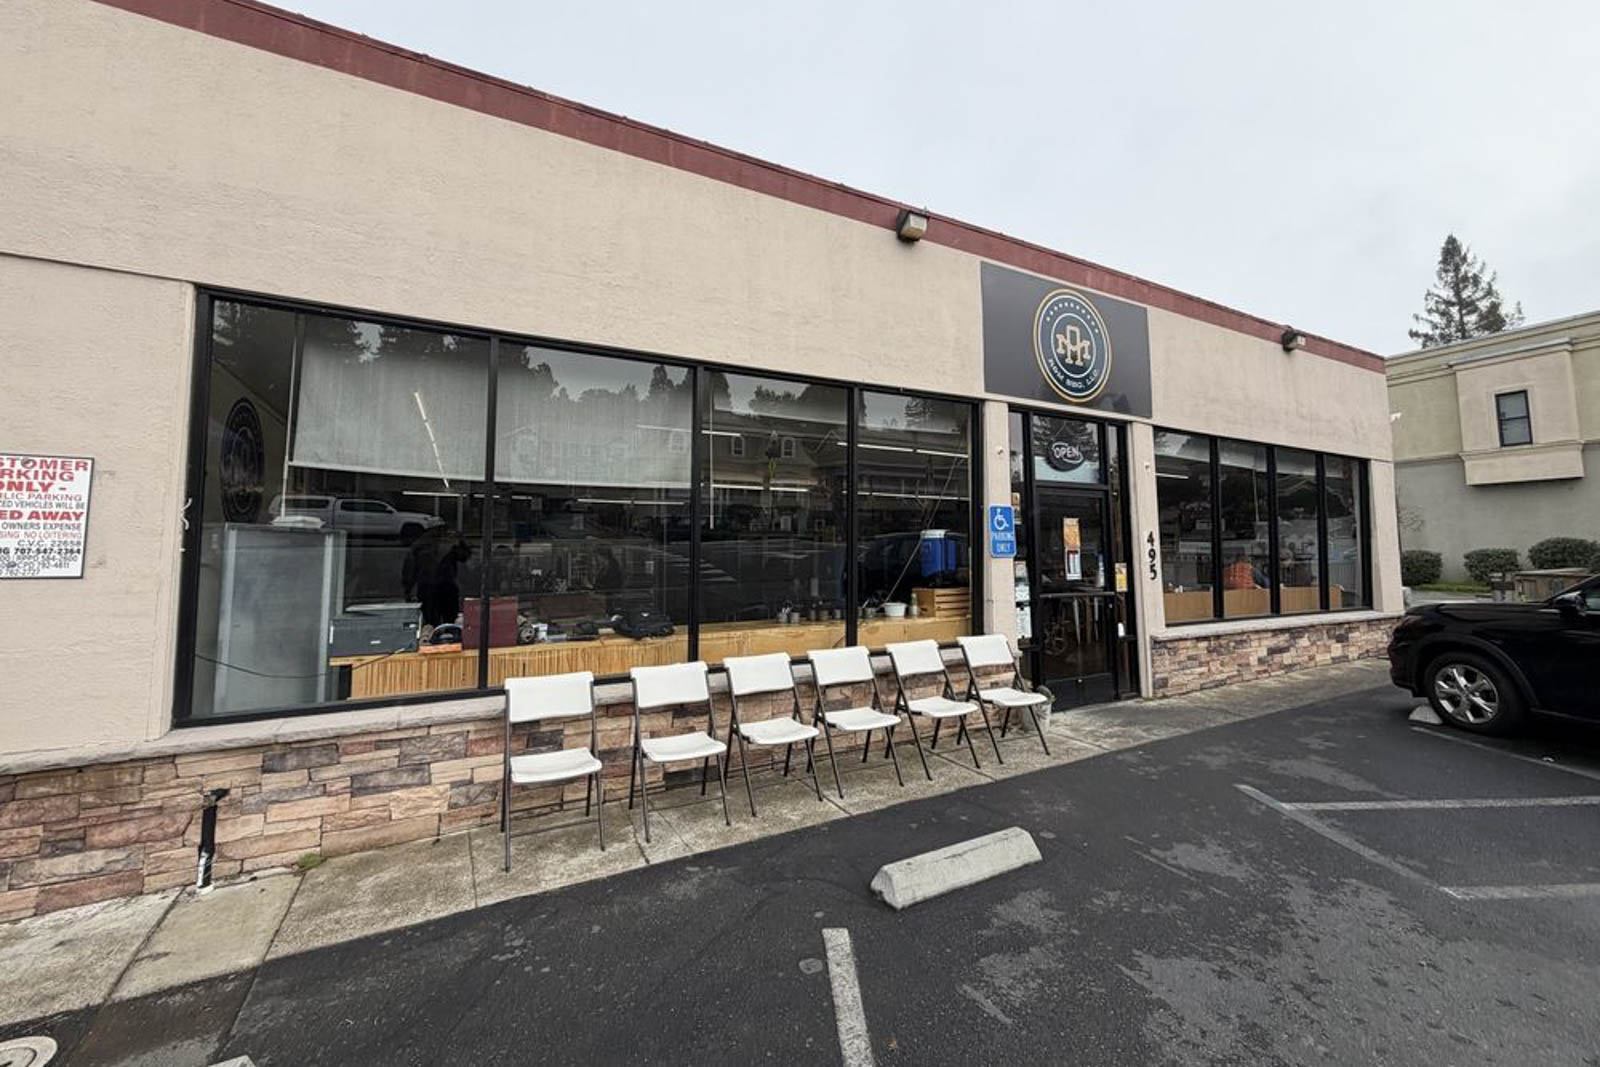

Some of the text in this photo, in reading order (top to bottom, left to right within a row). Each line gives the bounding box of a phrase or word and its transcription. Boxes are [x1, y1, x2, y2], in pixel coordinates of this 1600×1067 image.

[1054, 446, 1080, 459] OPEN
[28, 493, 82, 501] PARKING
[15, 501, 54, 509] VEHICLES
[76, 502, 85, 510] BE
[28, 510, 85, 521] AWAY
[43, 522, 82, 531] EXPENSE
[1146, 531, 1158, 580] 495
